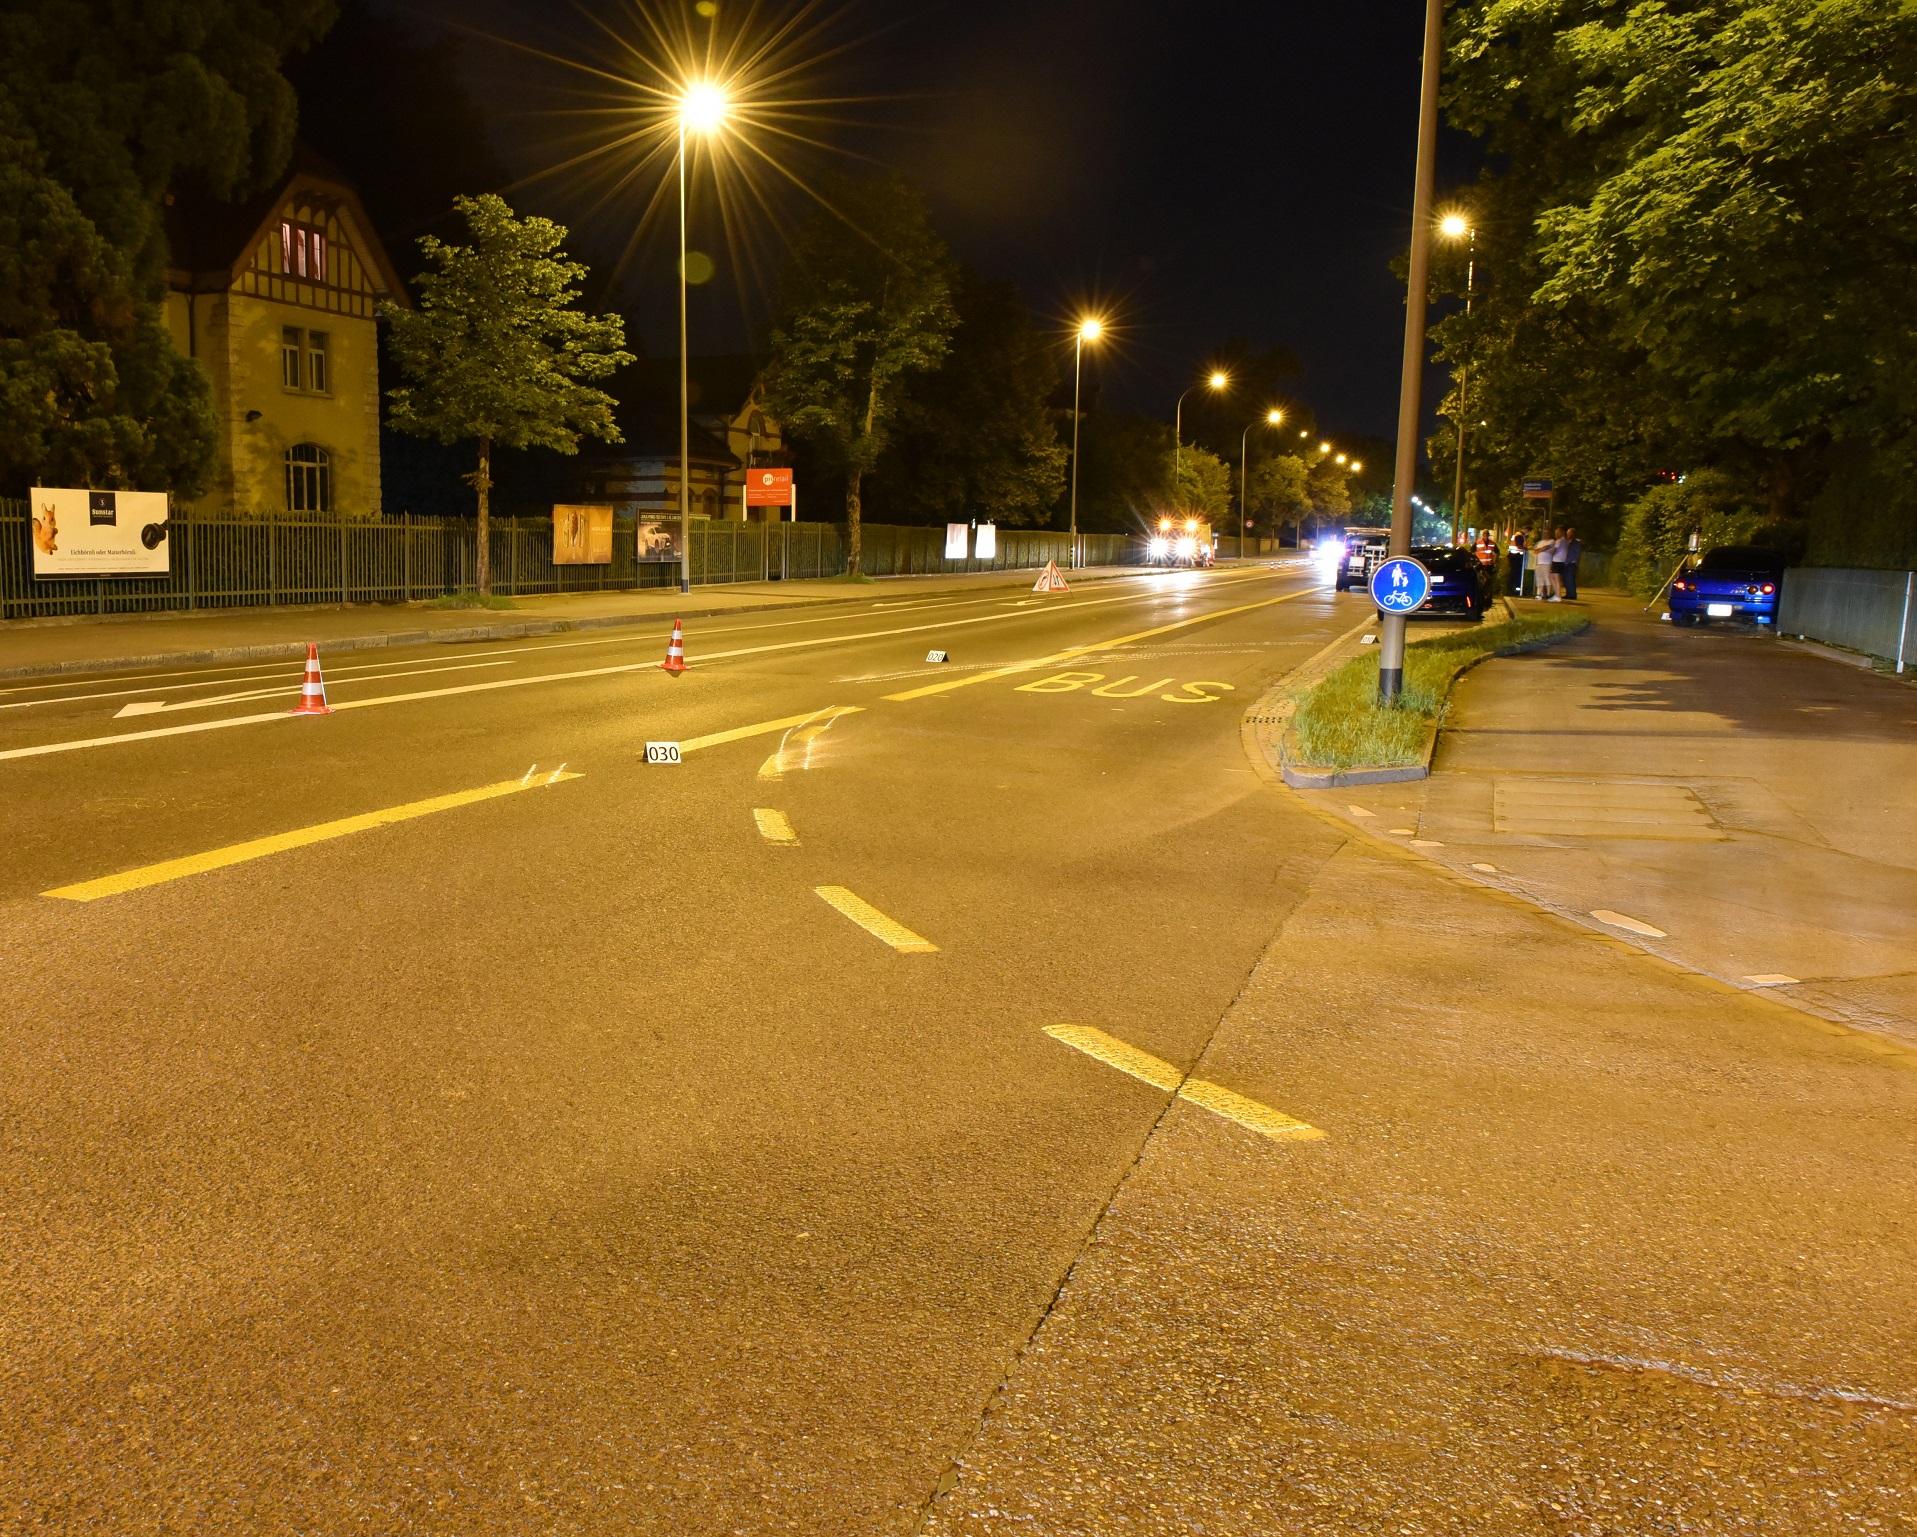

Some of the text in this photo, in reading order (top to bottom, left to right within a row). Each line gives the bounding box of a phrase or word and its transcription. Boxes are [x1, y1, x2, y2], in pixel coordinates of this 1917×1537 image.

[928, 652, 943, 662] 020
[1013, 671, 1235, 703] BUS
[649, 746, 679, 761] 030
